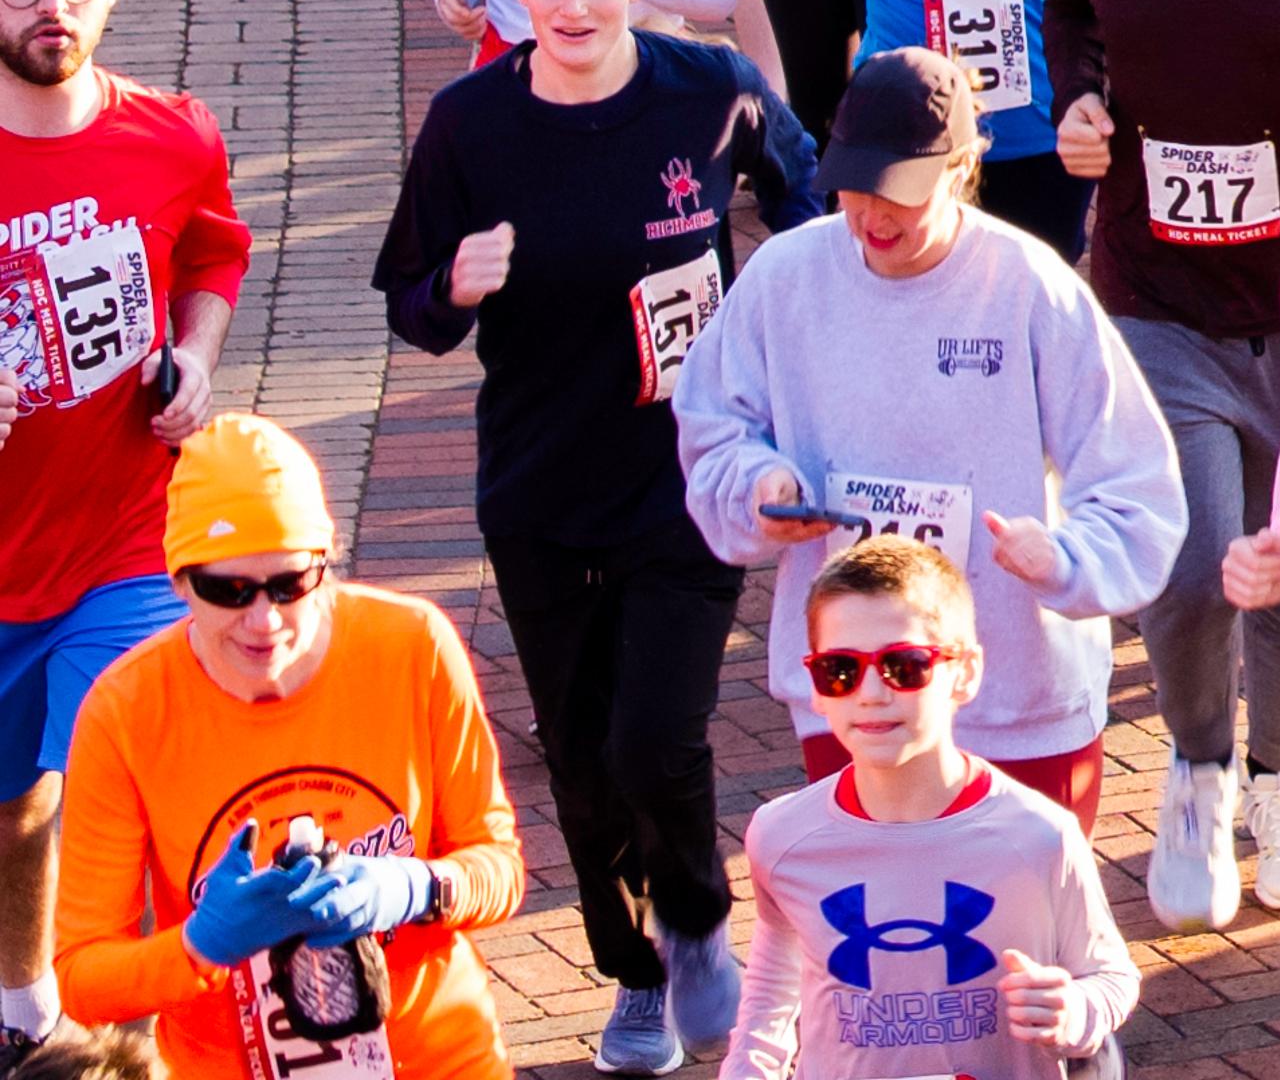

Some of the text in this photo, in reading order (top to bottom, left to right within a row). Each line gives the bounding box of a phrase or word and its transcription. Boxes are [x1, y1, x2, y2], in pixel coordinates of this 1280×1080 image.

[1010, 3, 1024, 54] SPIDER
[1000, 28, 1014, 68] DASH
[1160, 146, 1214, 163] SPIDER
[1186, 162, 1229, 175] DASH
[1164, 175, 1255, 224] 217
[1168, 225, 1268, 242] HDC MEAL TICKET
[126, 252, 148, 309] SPIDER
[56, 265, 124, 372] 135
[118, 283, 138, 326] DASH
[31, 279, 65, 387] HDC MEAL TICKET
[937, 337, 1003, 361] UR LIFTS
[845, 479, 906, 499] SPIDER
[871, 497, 920, 517] DASH
[335, 782, 357, 799] CITY
[833, 986, 999, 1022] UNDER
[840, 1016, 998, 1048] ARMOUR
